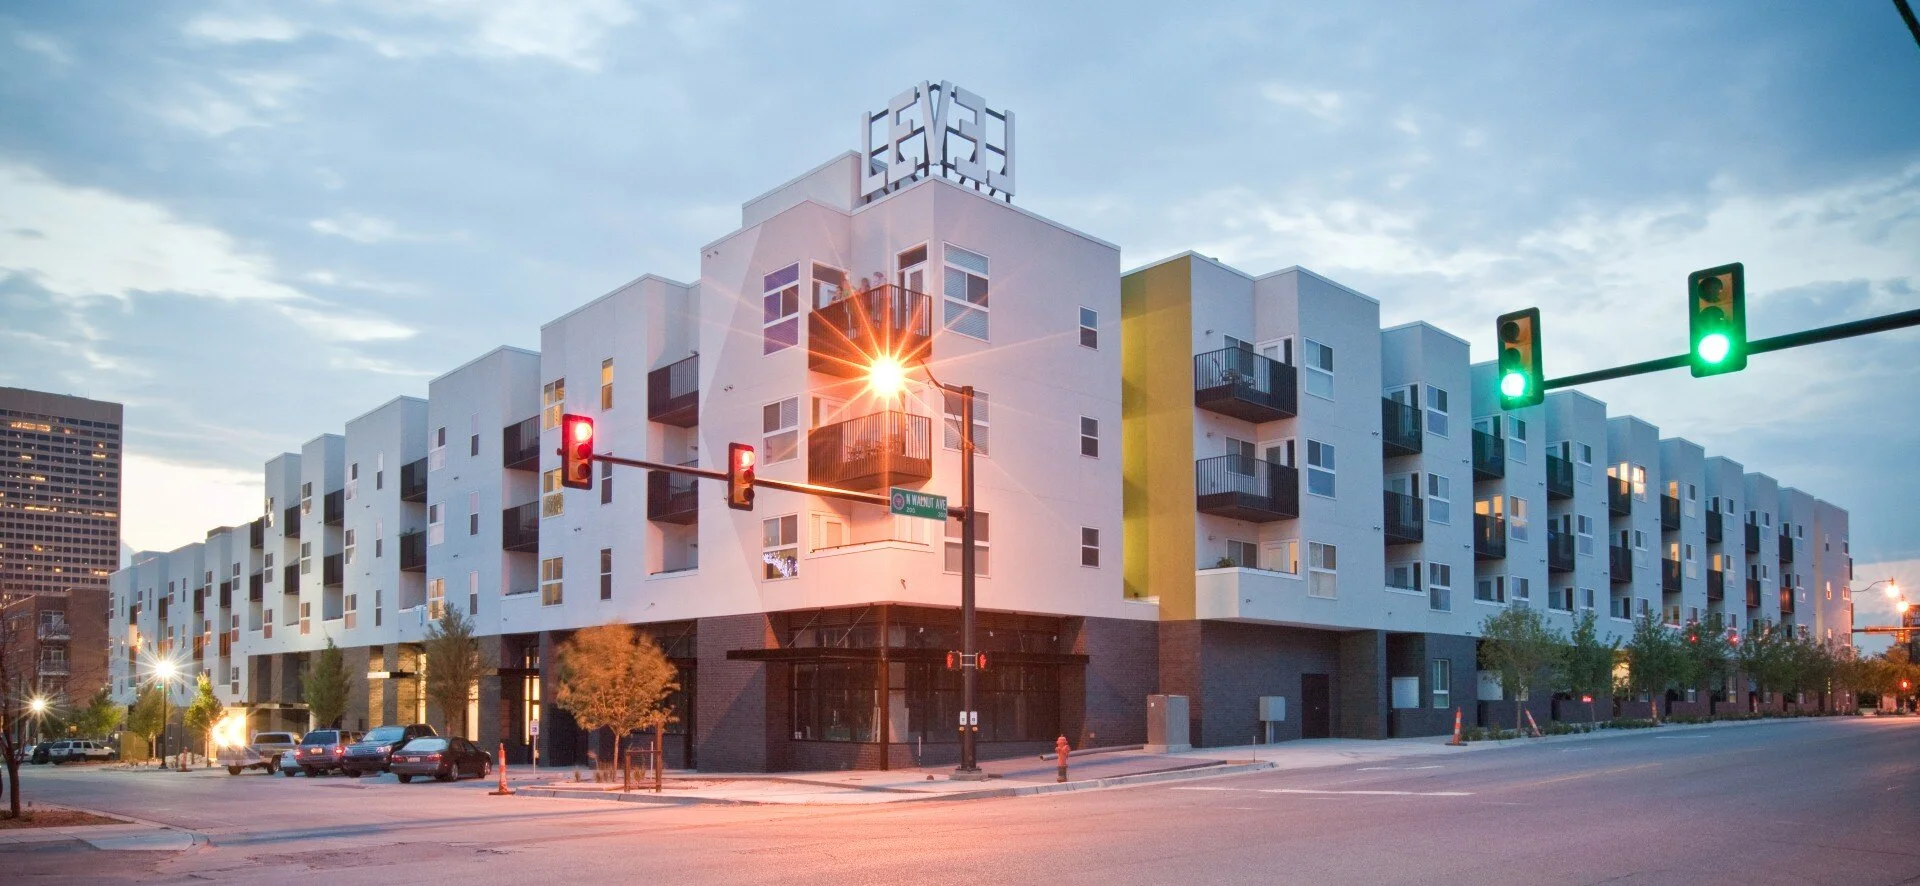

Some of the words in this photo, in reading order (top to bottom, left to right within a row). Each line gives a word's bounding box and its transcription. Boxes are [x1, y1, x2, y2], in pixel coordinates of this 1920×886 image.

[861, 80, 1015, 197] LEVEL
[906, 494, 911, 505] N
[912, 494, 934, 508] WALNUT
[936, 498, 946, 510] AVE
